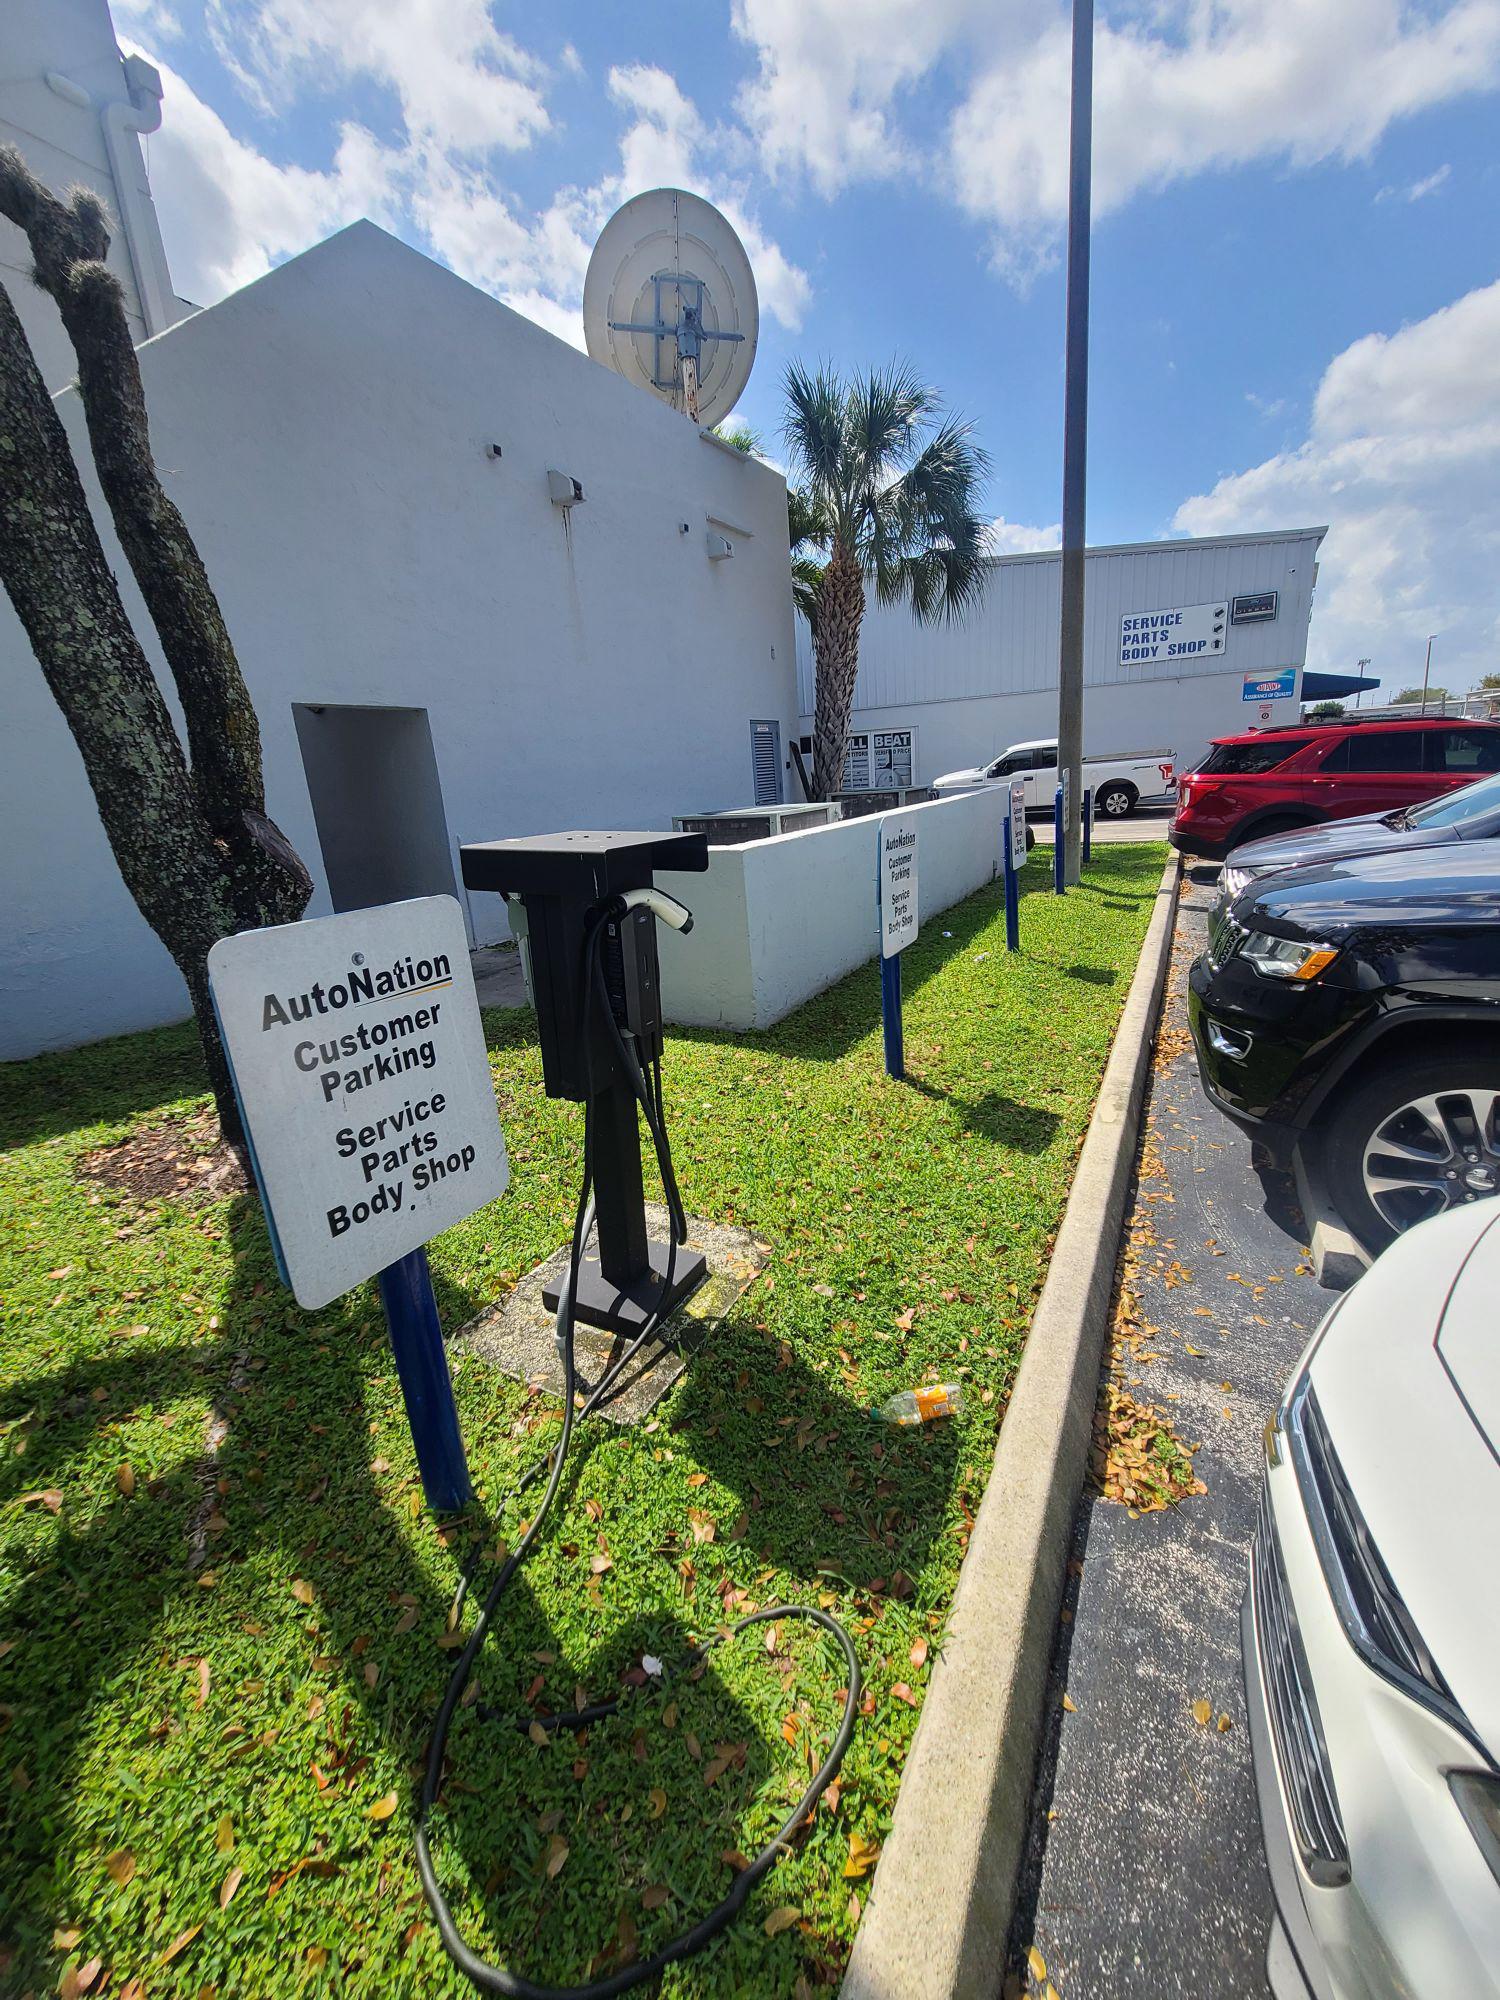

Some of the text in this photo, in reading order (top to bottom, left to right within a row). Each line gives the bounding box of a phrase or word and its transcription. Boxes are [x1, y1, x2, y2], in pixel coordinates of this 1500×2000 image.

[1123, 612, 1183, 632] SERVICE
[1122, 629, 1169, 647] PARTS
[1121, 639, 1207, 661] BODY SHOP
[847, 734, 909, 749] ILL BEAT
[885, 832, 916, 852] AutoNation
[888, 852, 913, 870] Customer
[891, 866, 910, 883] Parking
[891, 889, 910, 905] Service
[894, 904, 908, 918] Parts
[888, 914, 913, 935] Body Shop
[261, 953, 451, 1032] AutoNation
[293, 1003, 441, 1073] Customer
[320, 1039, 437, 1103] Parking
[335, 1092, 447, 1159] Service
[361, 1129, 439, 1183] Parts
[327, 1142, 476, 1238] Body Shop
